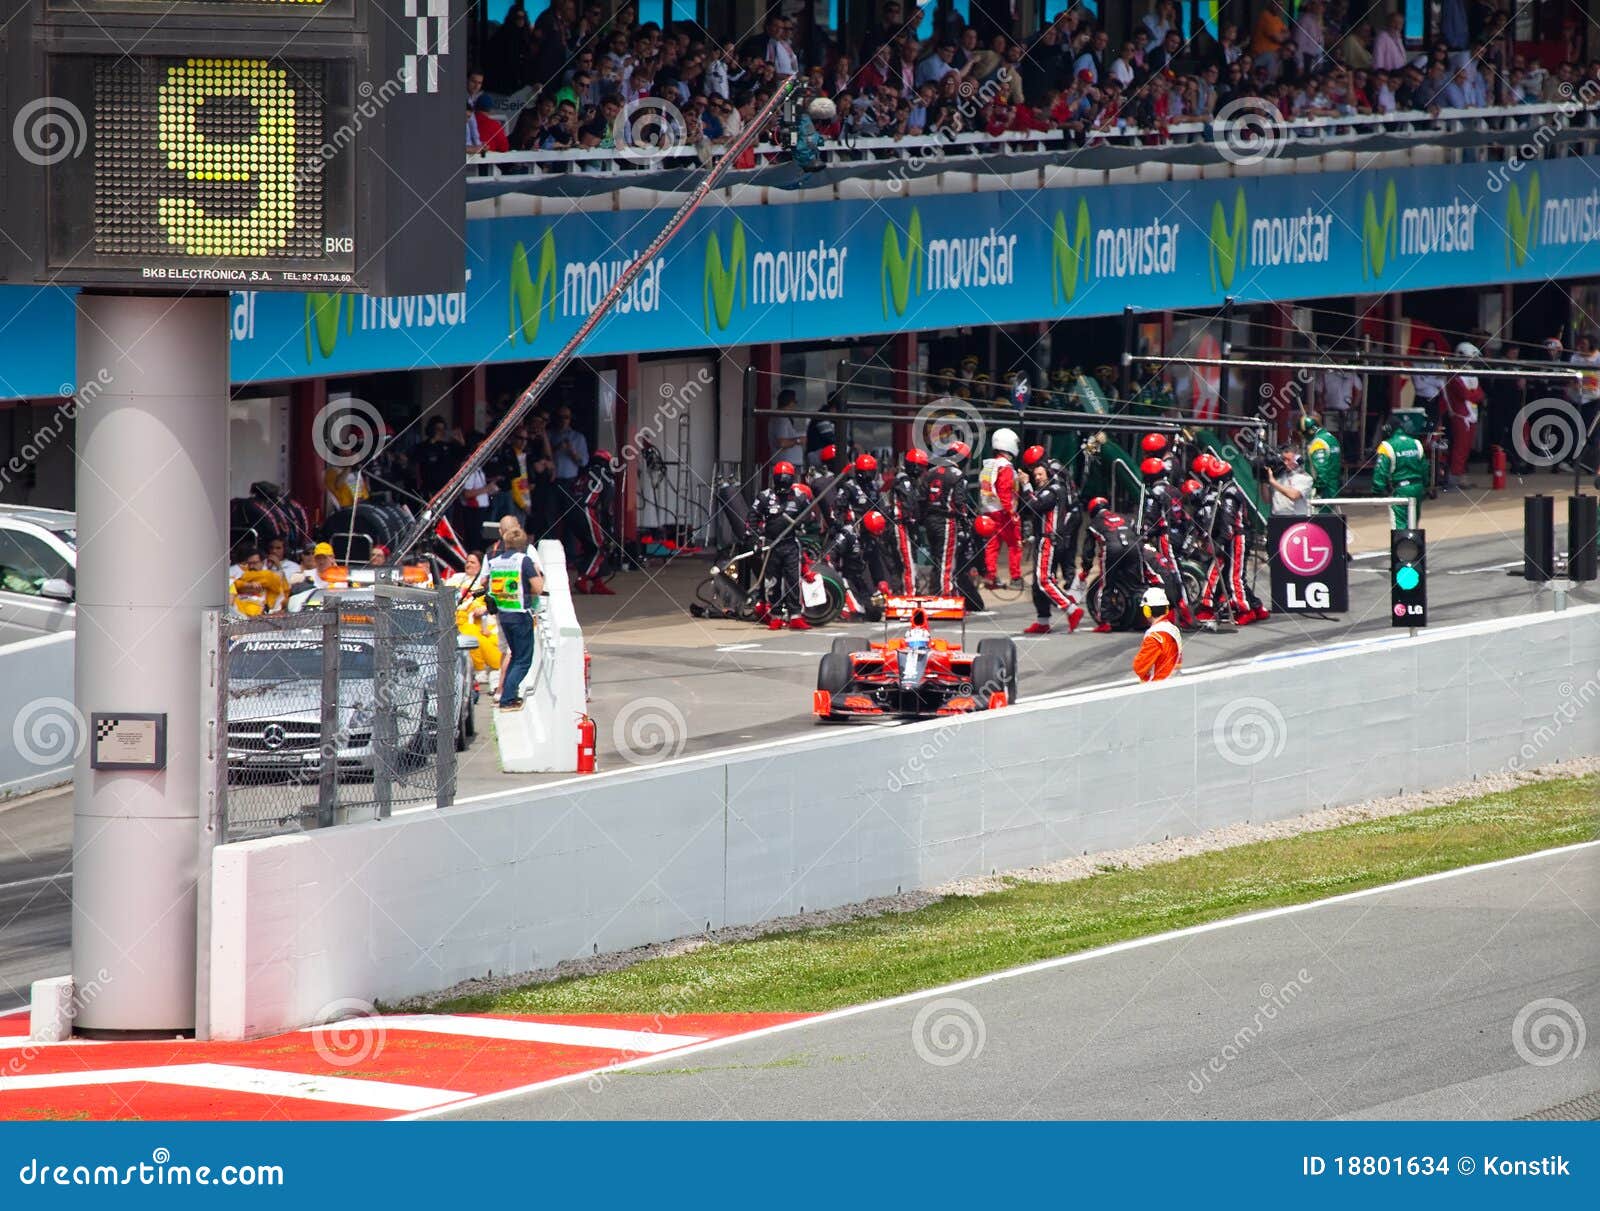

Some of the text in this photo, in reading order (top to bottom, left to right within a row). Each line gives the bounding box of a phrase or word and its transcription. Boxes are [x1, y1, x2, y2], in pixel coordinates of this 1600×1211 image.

[158, 57, 296, 257] 9
[325, 237, 354, 252] BKB
[1251, 207, 1334, 266] movistar
[1400, 196, 1478, 256] movistar
[1542, 187, 1600, 246] movist
[142, 268, 166, 278] BKB
[168, 270, 246, 281] ELECTRONICA
[753, 239, 848, 304] movistar
[928, 227, 1017, 291] movistar
[1096, 216, 1180, 279] movistar
[361, 268, 471, 330] movistar
[563, 250, 665, 317] movistar
[1286, 582, 1330, 609] LG
[1407, 604, 1423, 615] LG
[244, 640, 364, 653] Mercedes-nz
